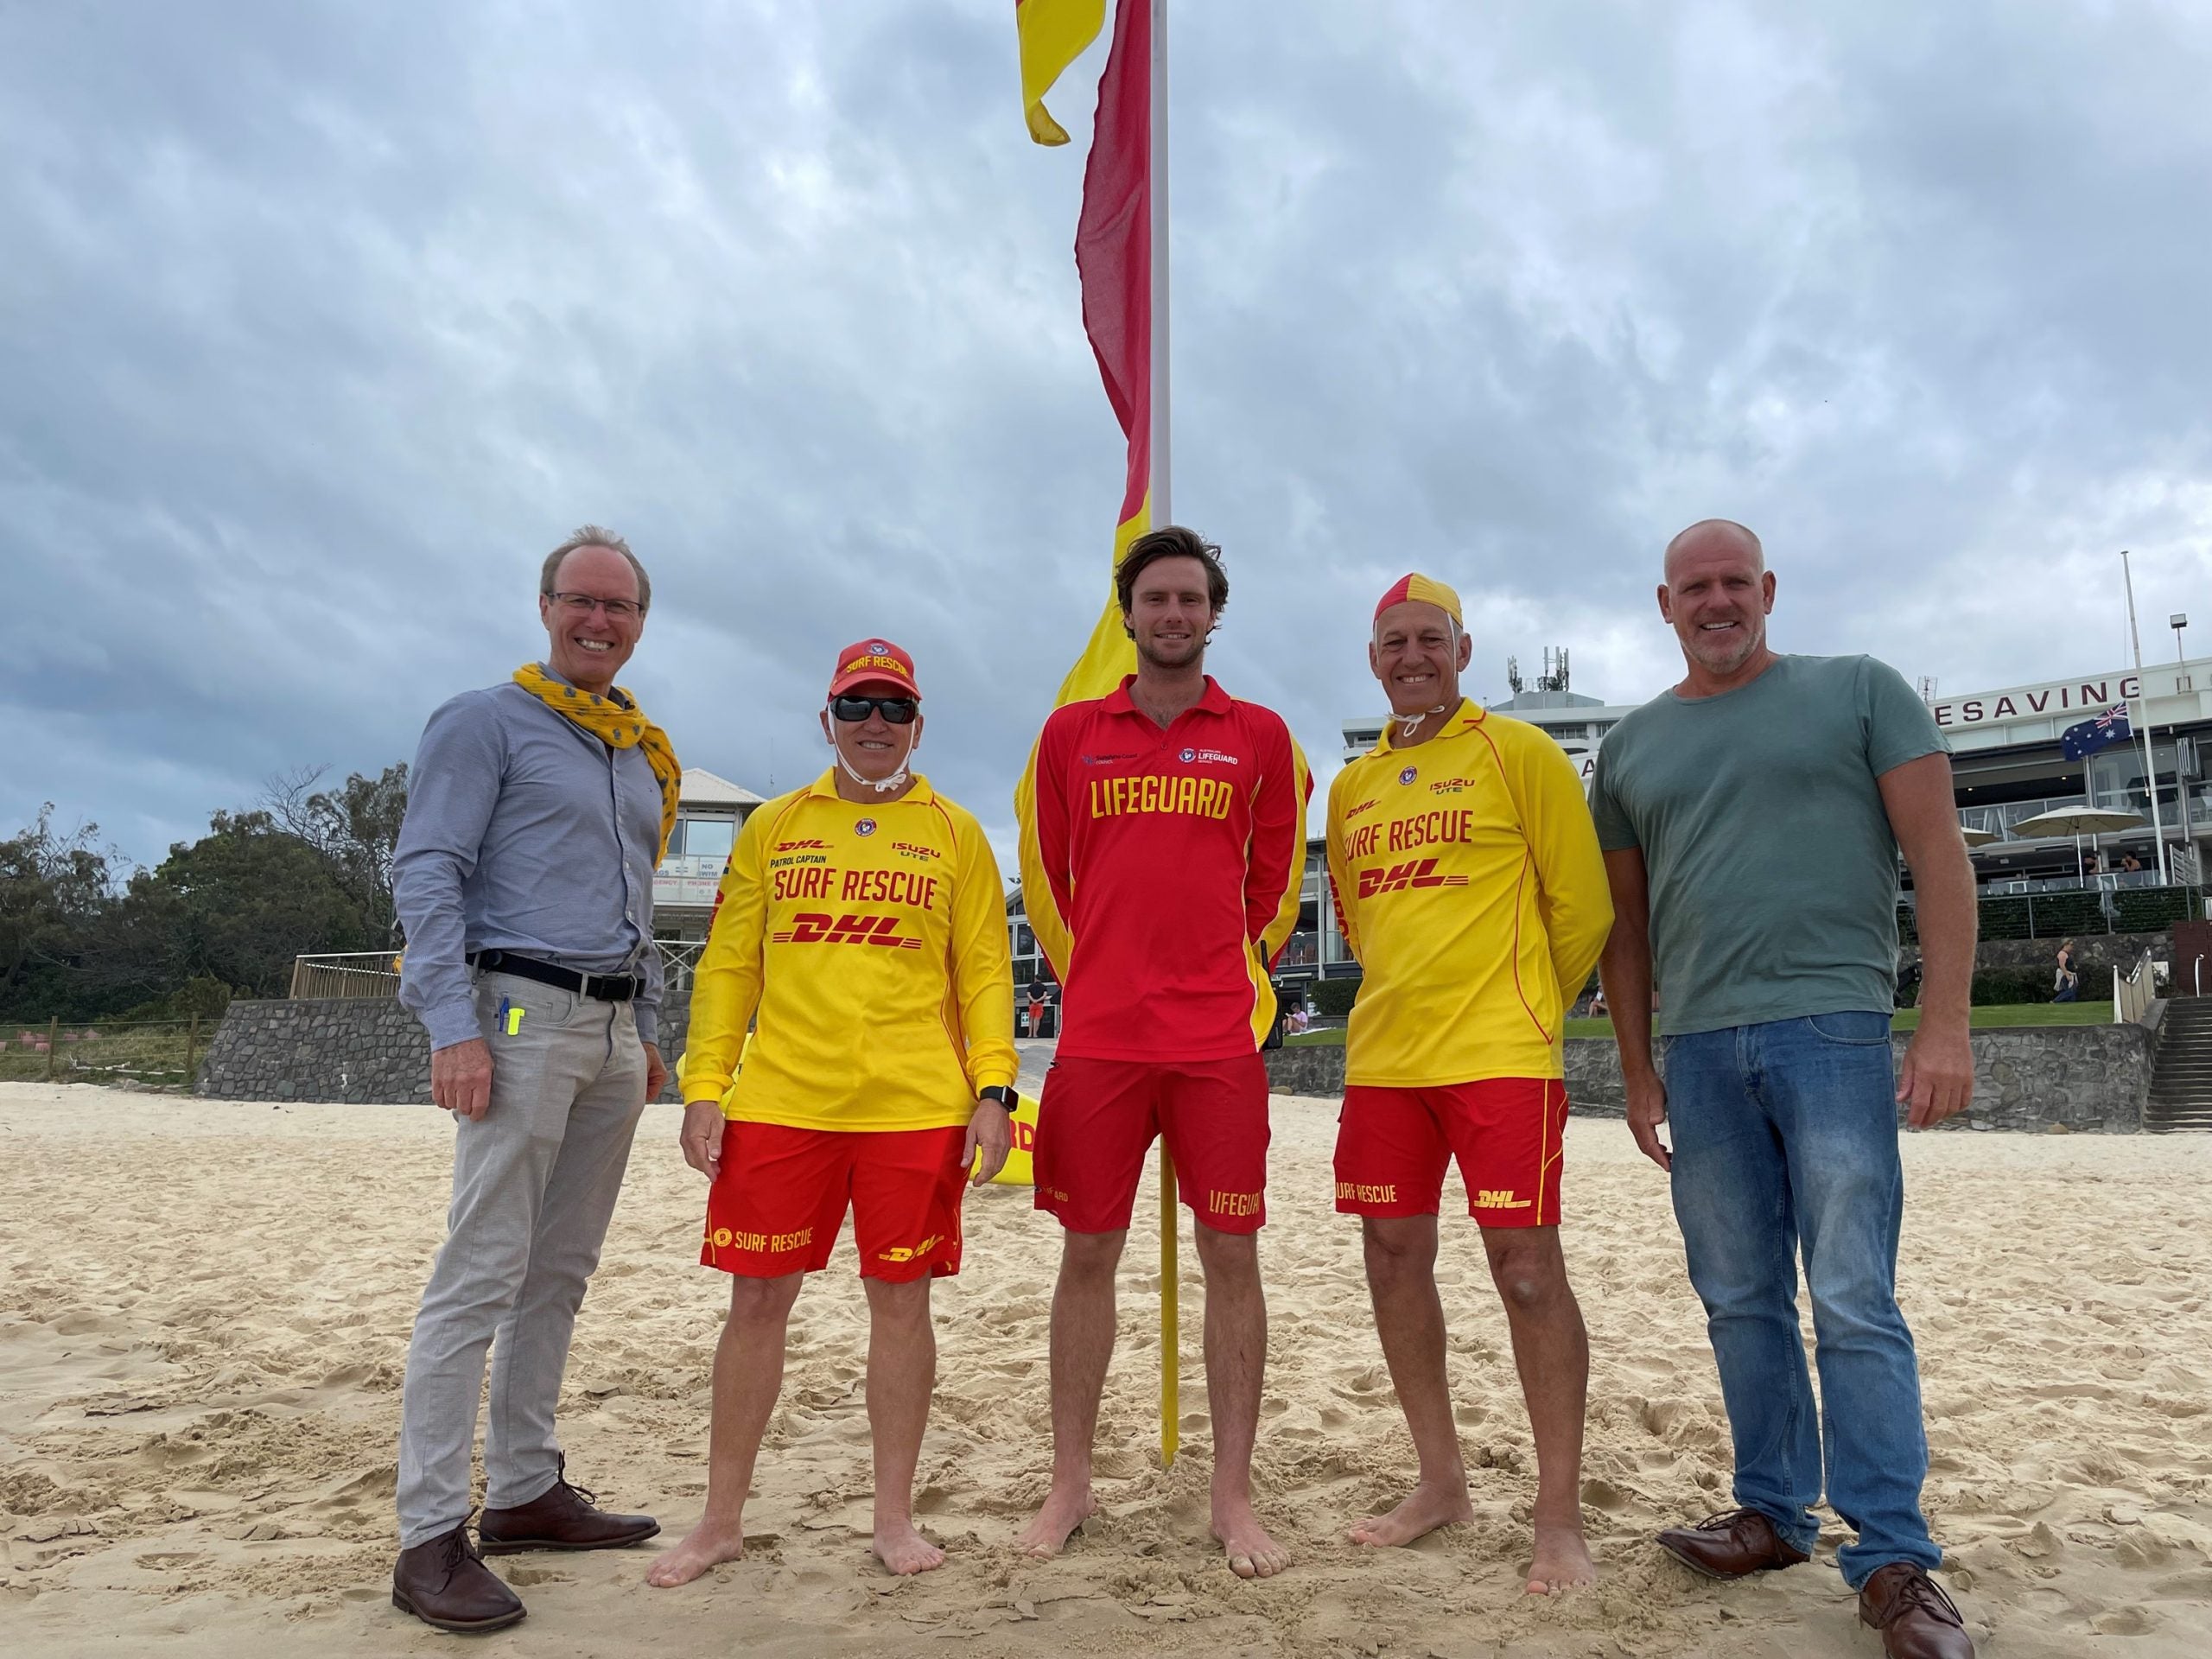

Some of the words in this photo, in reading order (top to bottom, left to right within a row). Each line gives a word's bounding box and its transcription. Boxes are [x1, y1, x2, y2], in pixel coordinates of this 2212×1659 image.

[847, 656, 871, 673] SURF
[874, 656, 909, 678] RESCUE
[1198, 753, 1238, 766] LIFEGUARD
[1430, 779, 1476, 791] ISUZU
[1090, 775, 1234, 820] LIFEGUARD
[1345, 798, 1376, 820] DHL
[1389, 810, 1474, 853] RESCUE
[778, 839, 825, 852] DHL
[891, 842, 941, 859] ISUZU
[900, 851, 930, 862] UTE
[770, 857, 794, 868] PATROL
[796, 855, 827, 864] CAPTAIN
[774, 867, 837, 901] SURF
[842, 869, 938, 911] RESCUE
[1357, 857, 1446, 899] DHL
[791, 912, 906, 945] DHL
[1210, 1189, 1262, 1217] LIFEGUA
[1357, 1185, 1397, 1203] RESCUE
[1478, 1190, 1518, 1209] DHL
[735, 1230, 767, 1252] SURF
[771, 1227, 814, 1253] RESCUE
[888, 1234, 939, 1262] DHL
